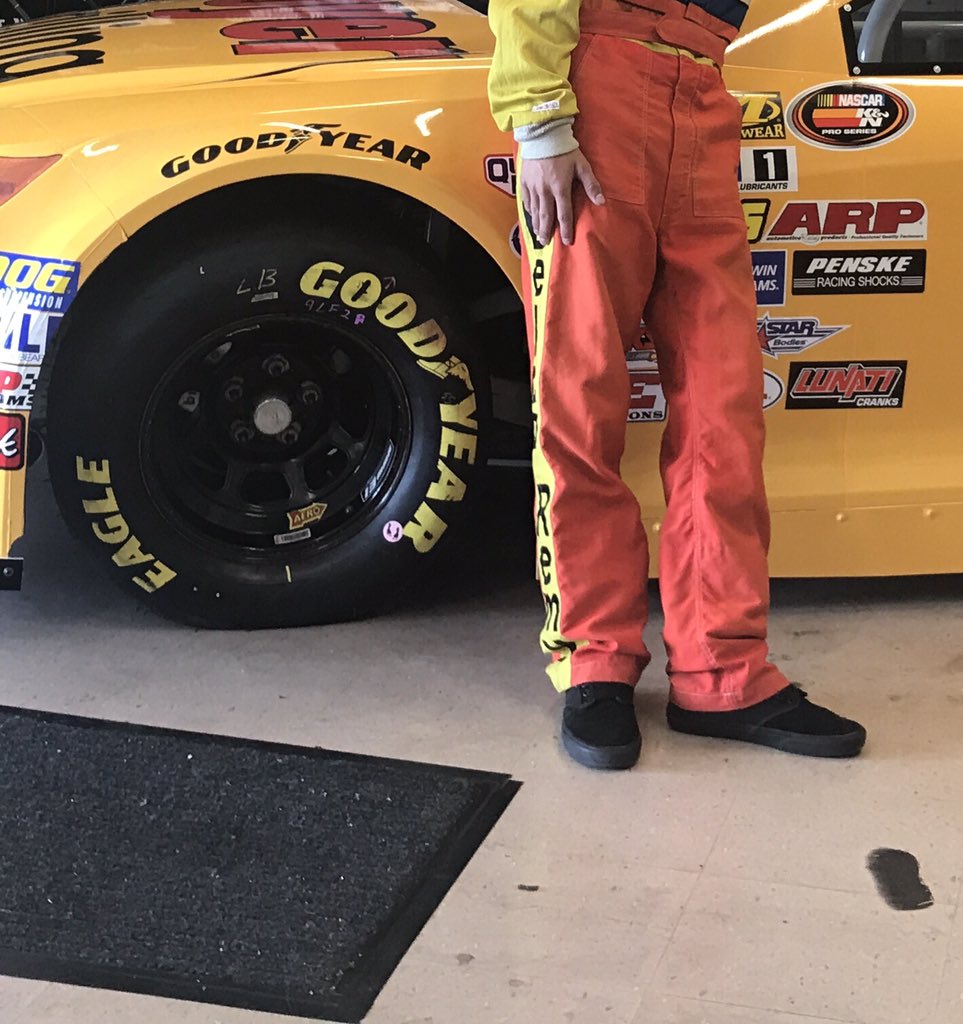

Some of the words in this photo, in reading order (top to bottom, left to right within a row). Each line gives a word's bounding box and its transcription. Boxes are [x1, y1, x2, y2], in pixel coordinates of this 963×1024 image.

[839, 94, 885, 107] NASCAR
[741, 127, 784, 139] WEAR
[161, 123, 431, 179] GOODYEAR
[768, 201, 925, 235] ARP
[806, 257, 912, 273] PENSKE
[816, 277, 855, 287] RACING
[858, 276, 900, 286] SHOCKS
[794, 365, 899, 397] LUNATI
[300, 260, 478, 553] GOODYEAR
[856, 397, 898, 406] CRANKS
[294, 506, 320, 523] AERO
[76, 455, 177, 593] EAGLE
